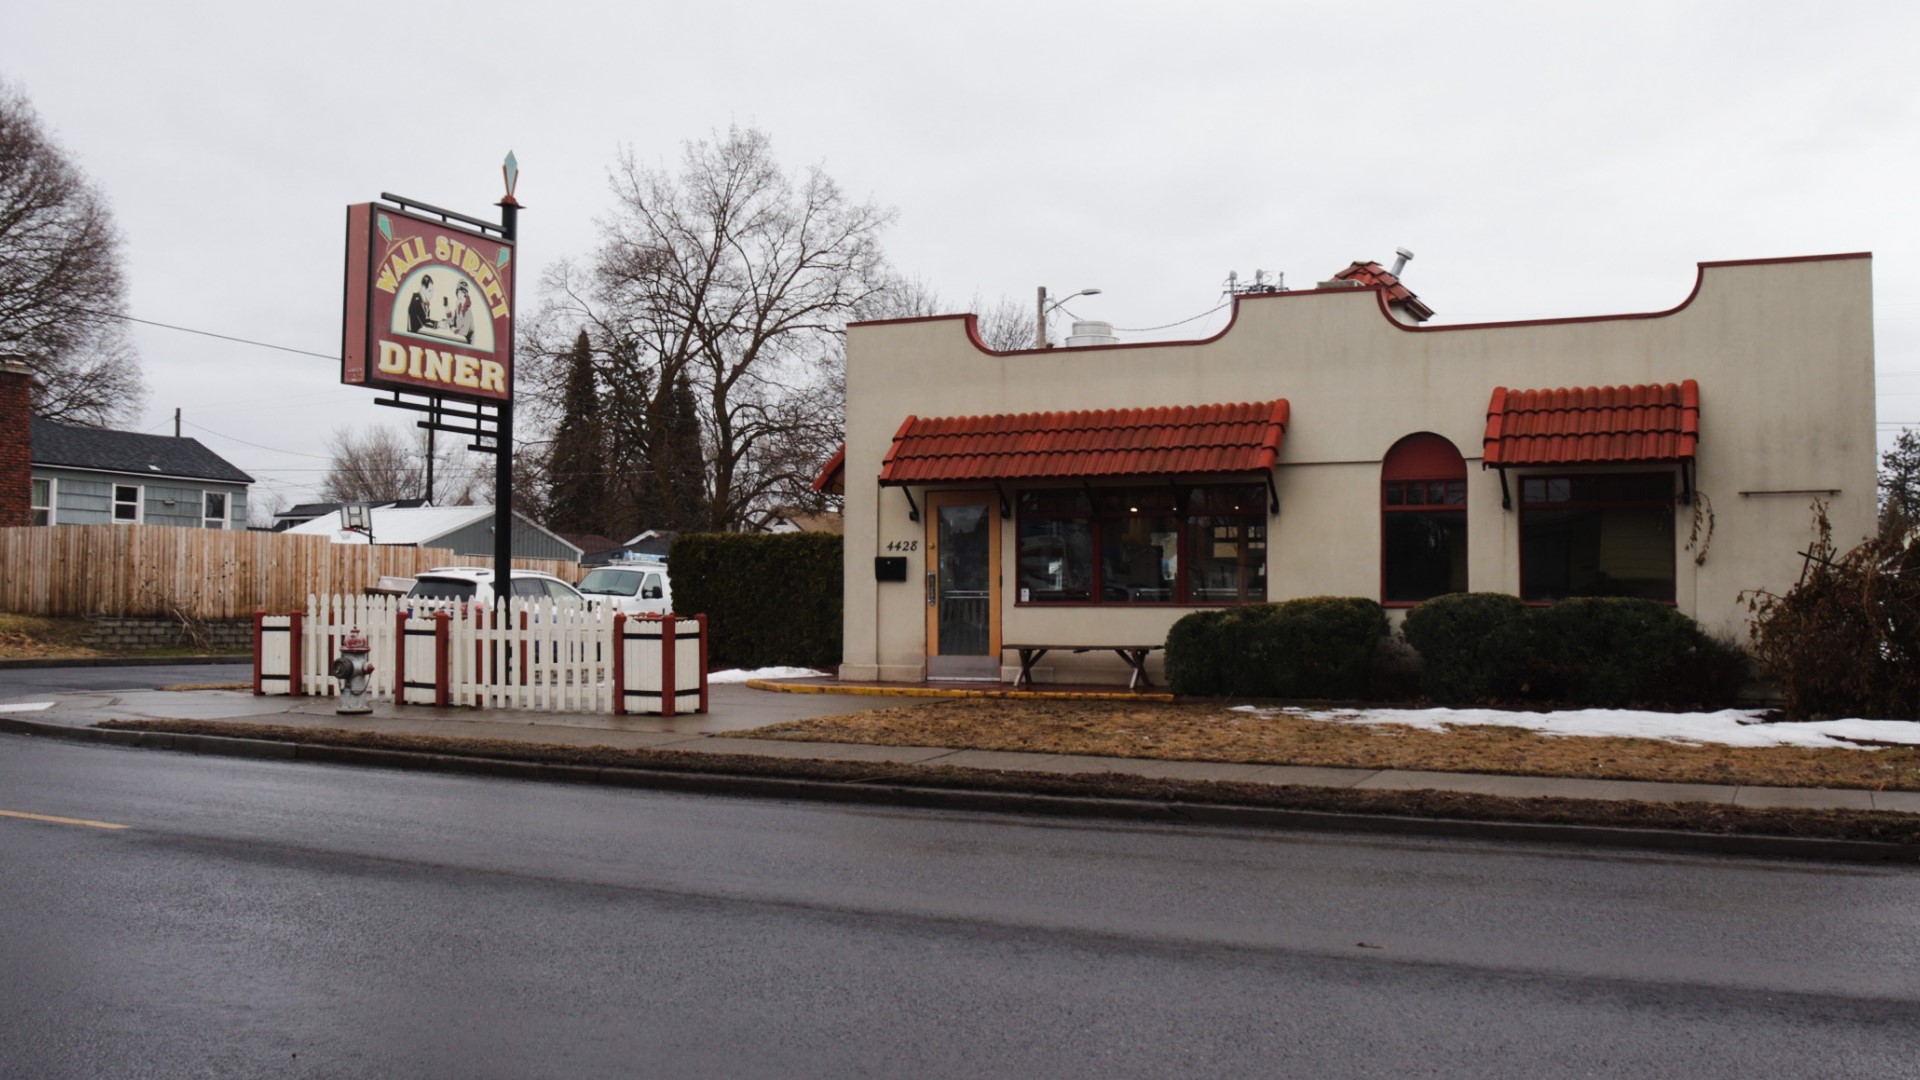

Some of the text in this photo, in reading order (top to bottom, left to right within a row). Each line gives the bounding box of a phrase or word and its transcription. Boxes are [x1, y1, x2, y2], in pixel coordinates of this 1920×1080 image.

[376, 235, 510, 319] WALL STREET
[378, 339, 505, 393] DINER
[887, 540, 918, 551] 4428
